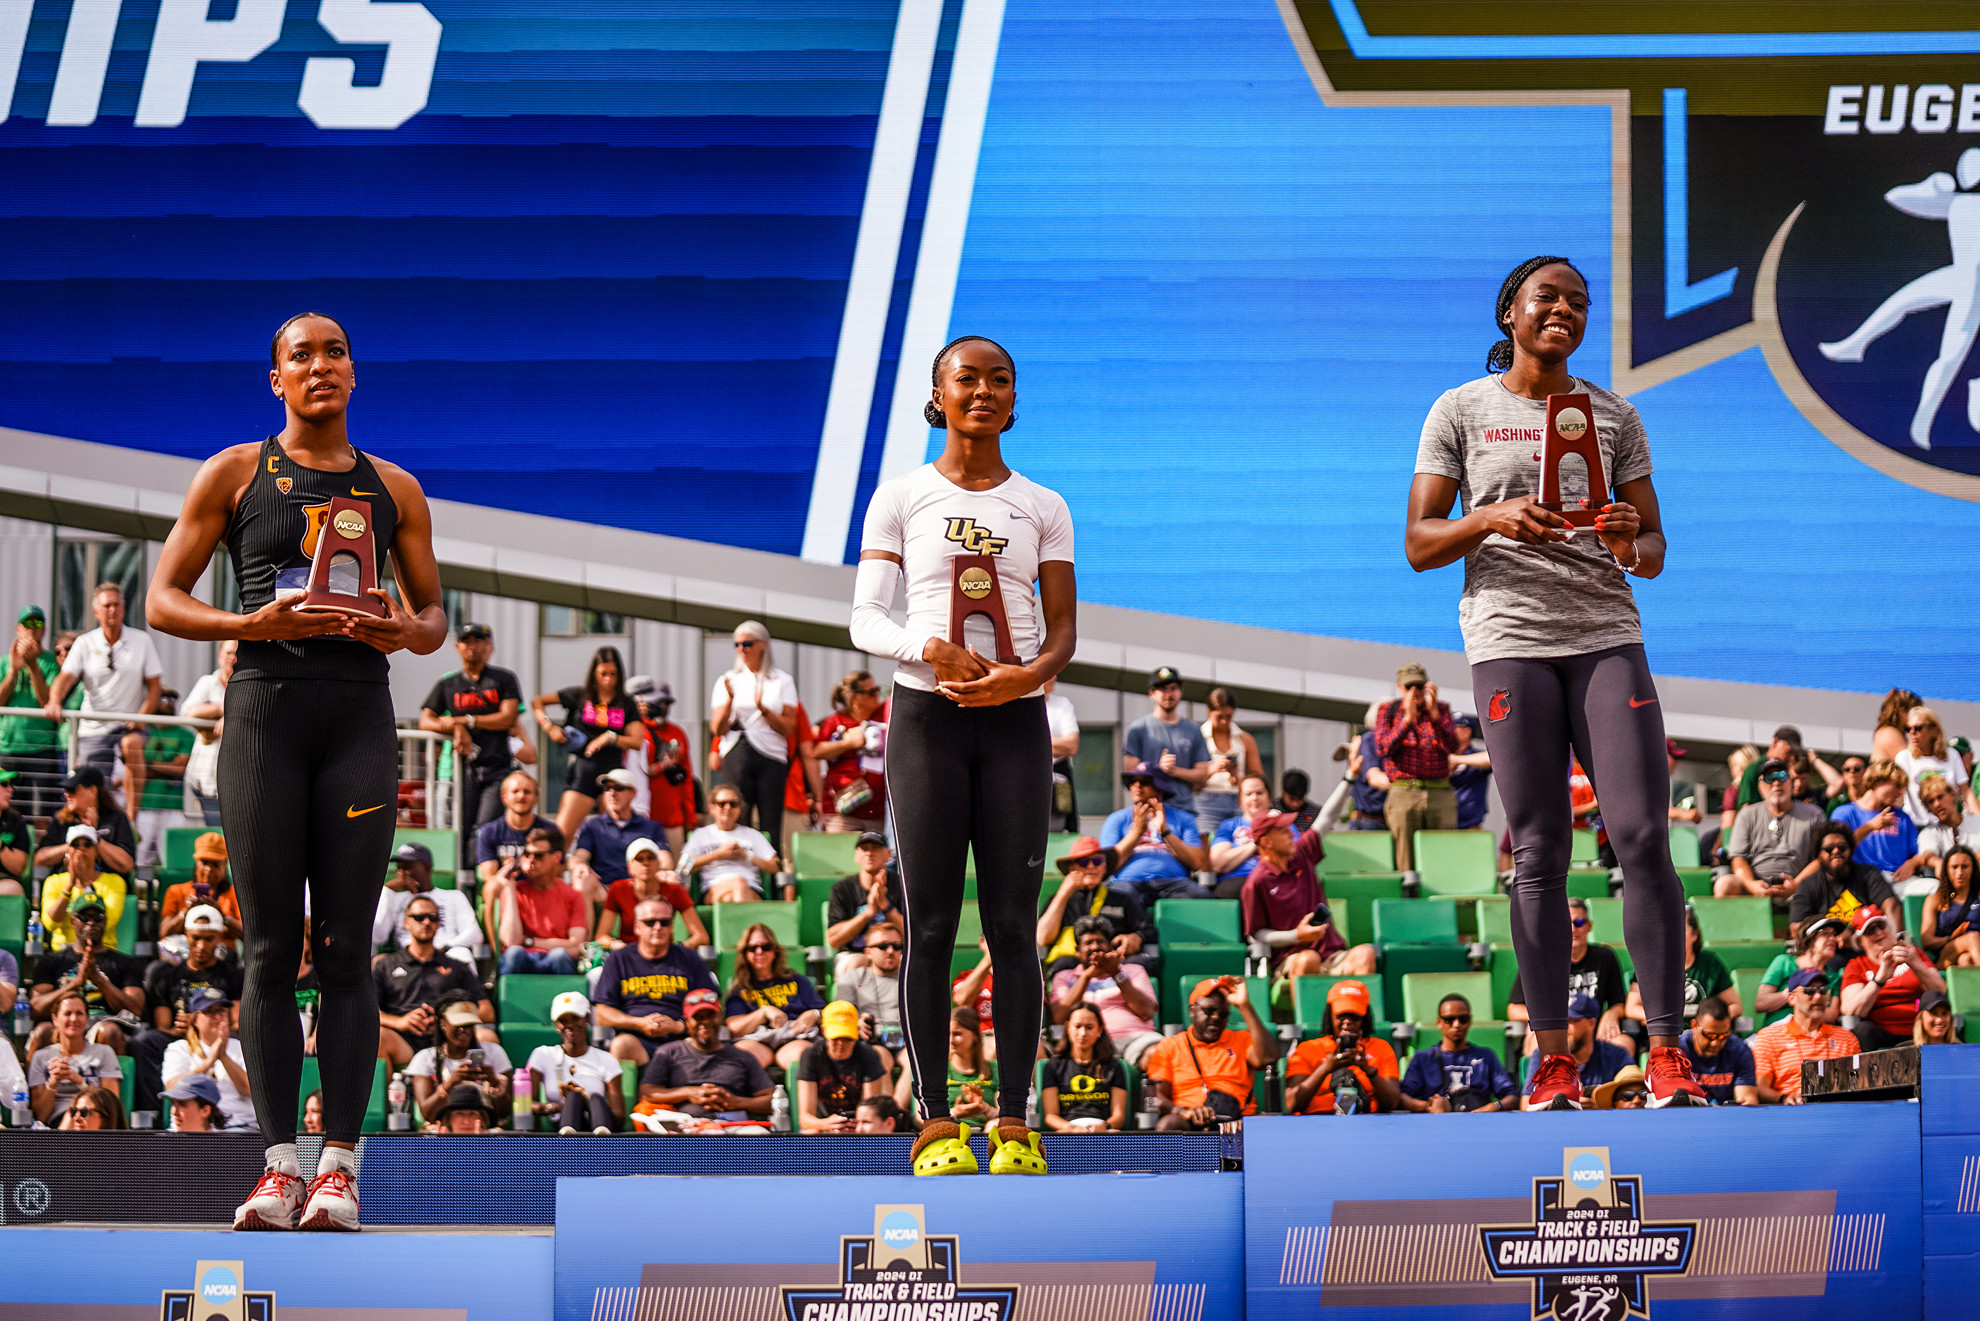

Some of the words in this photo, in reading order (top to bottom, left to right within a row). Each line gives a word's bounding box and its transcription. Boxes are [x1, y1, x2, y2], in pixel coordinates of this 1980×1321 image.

[1483, 428, 1544, 443] WASHING
[335, 520, 366, 533] NCAA
[943, 517, 1009, 556] UCF
[962, 581, 992, 592] NCAA
[1573, 1170, 1605, 1182] NCAA
[1566, 1209, 1594, 1219] 2024
[884, 1229, 919, 1241] NCAA
[1537, 1221, 1584, 1238] TRACK
[1586, 1221, 1598, 1237] &
[1600, 1219, 1640, 1237] FIELD
[1500, 1236, 1681, 1265] CHAMPIONSHIPS
[876, 1271, 906, 1281] 2024
[1562, 1275, 1602, 1285] EUGENE,
[1604, 1274, 1618, 1284] OR
[203, 1284, 237, 1297] NCAA
[844, 1283, 895, 1301] TRACK
[896, 1283, 909, 1301] &
[911, 1282, 956, 1300] FIELD
[803, 1302, 999, 1321] CHAMPIONSHIPS
